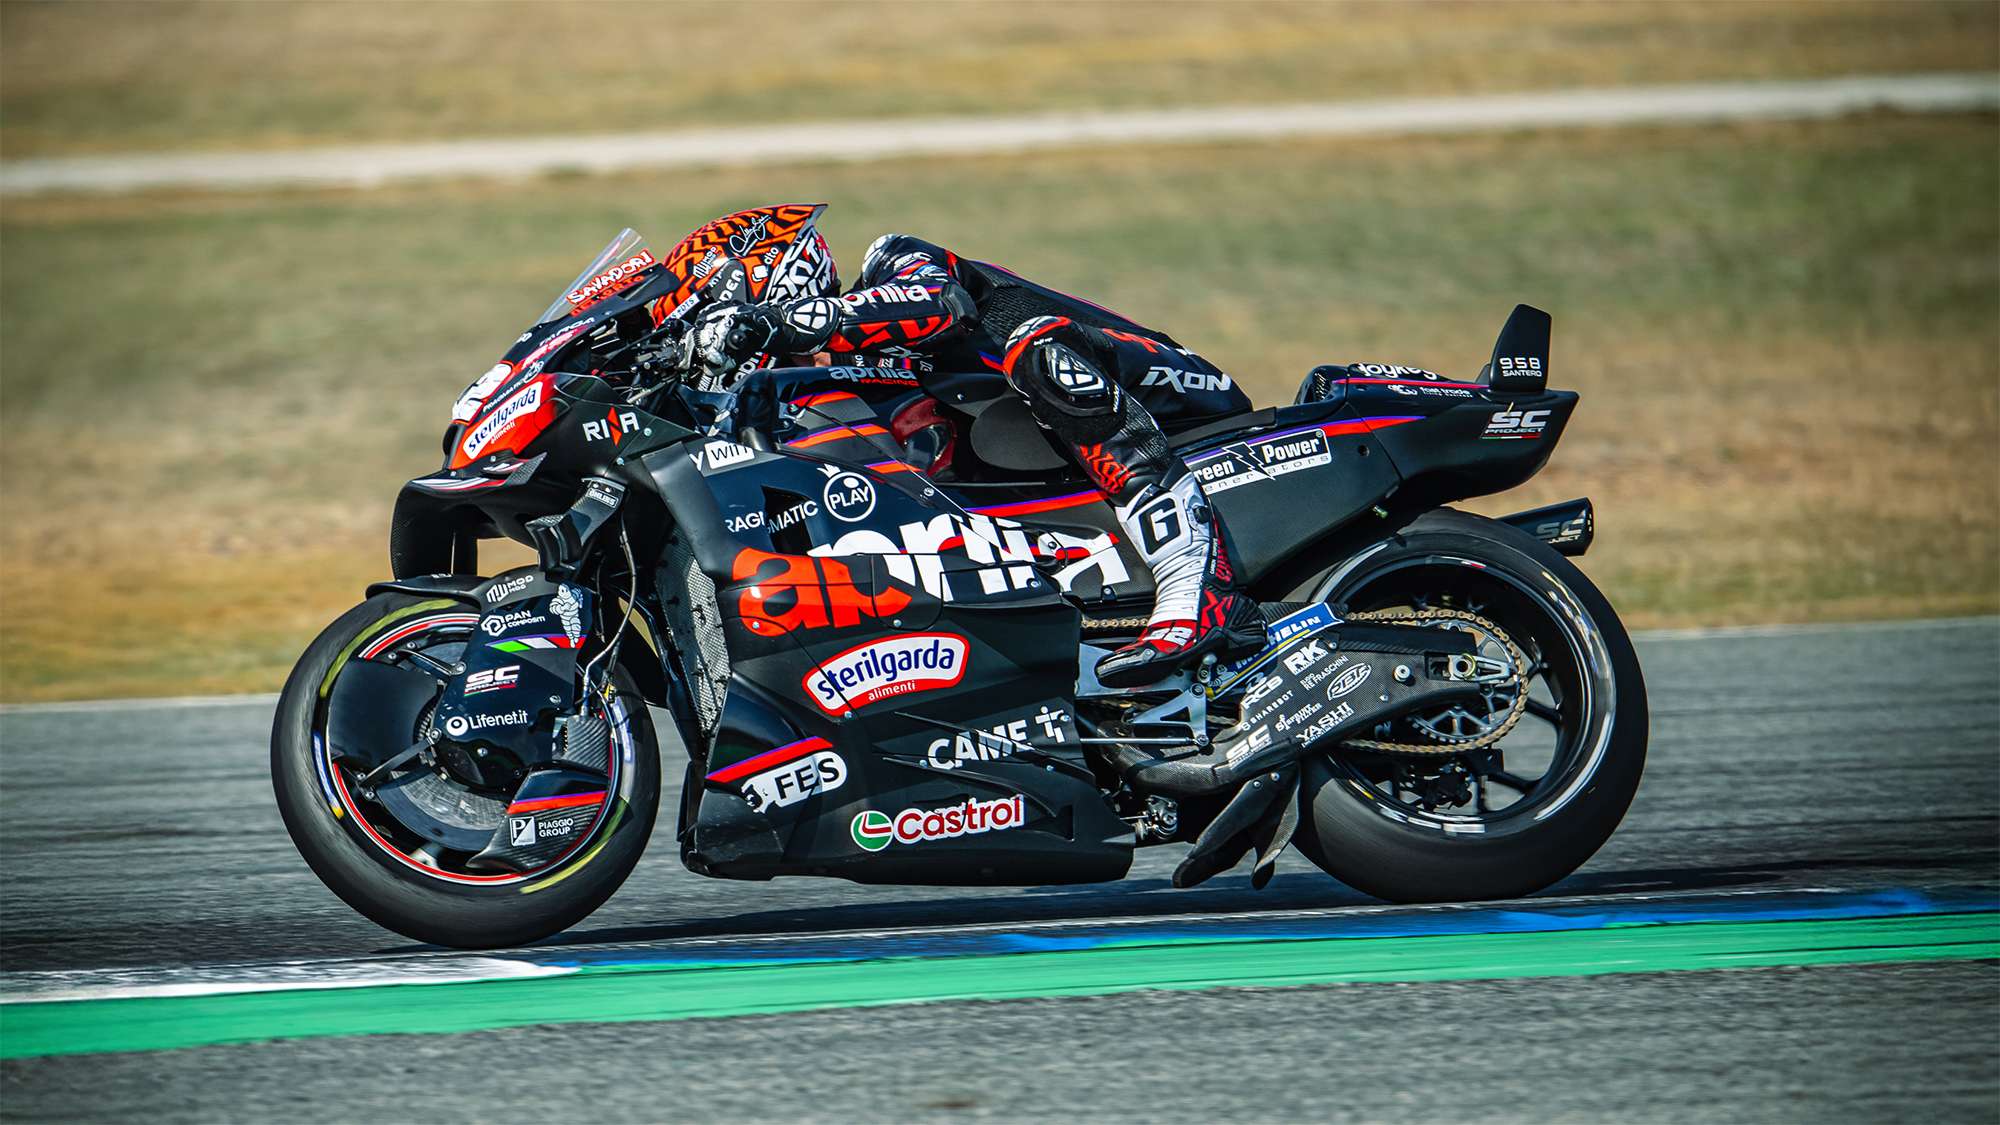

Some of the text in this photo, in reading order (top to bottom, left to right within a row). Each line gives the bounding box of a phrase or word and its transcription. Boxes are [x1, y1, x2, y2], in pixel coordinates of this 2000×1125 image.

[829, 367, 917, 382] aprilia
[468, 388, 536, 451] sterilgarda
[1487, 410, 1551, 428] SC
[1261, 438, 1320, 464] Power
[829, 486, 871, 510] PLAY
[505, 610, 532, 623] PAN
[1284, 638, 1327, 674] RK
[816, 639, 955, 700] sterilgarda
[868, 680, 916, 701] alimenti
[469, 710, 528, 730] Lifenet.it
[1296, 701, 1351, 742] YASHI
[538, 817, 574, 830] PIAGGIO
[897, 796, 1021, 840] Castrol
[539, 826, 571, 838] GROUP
